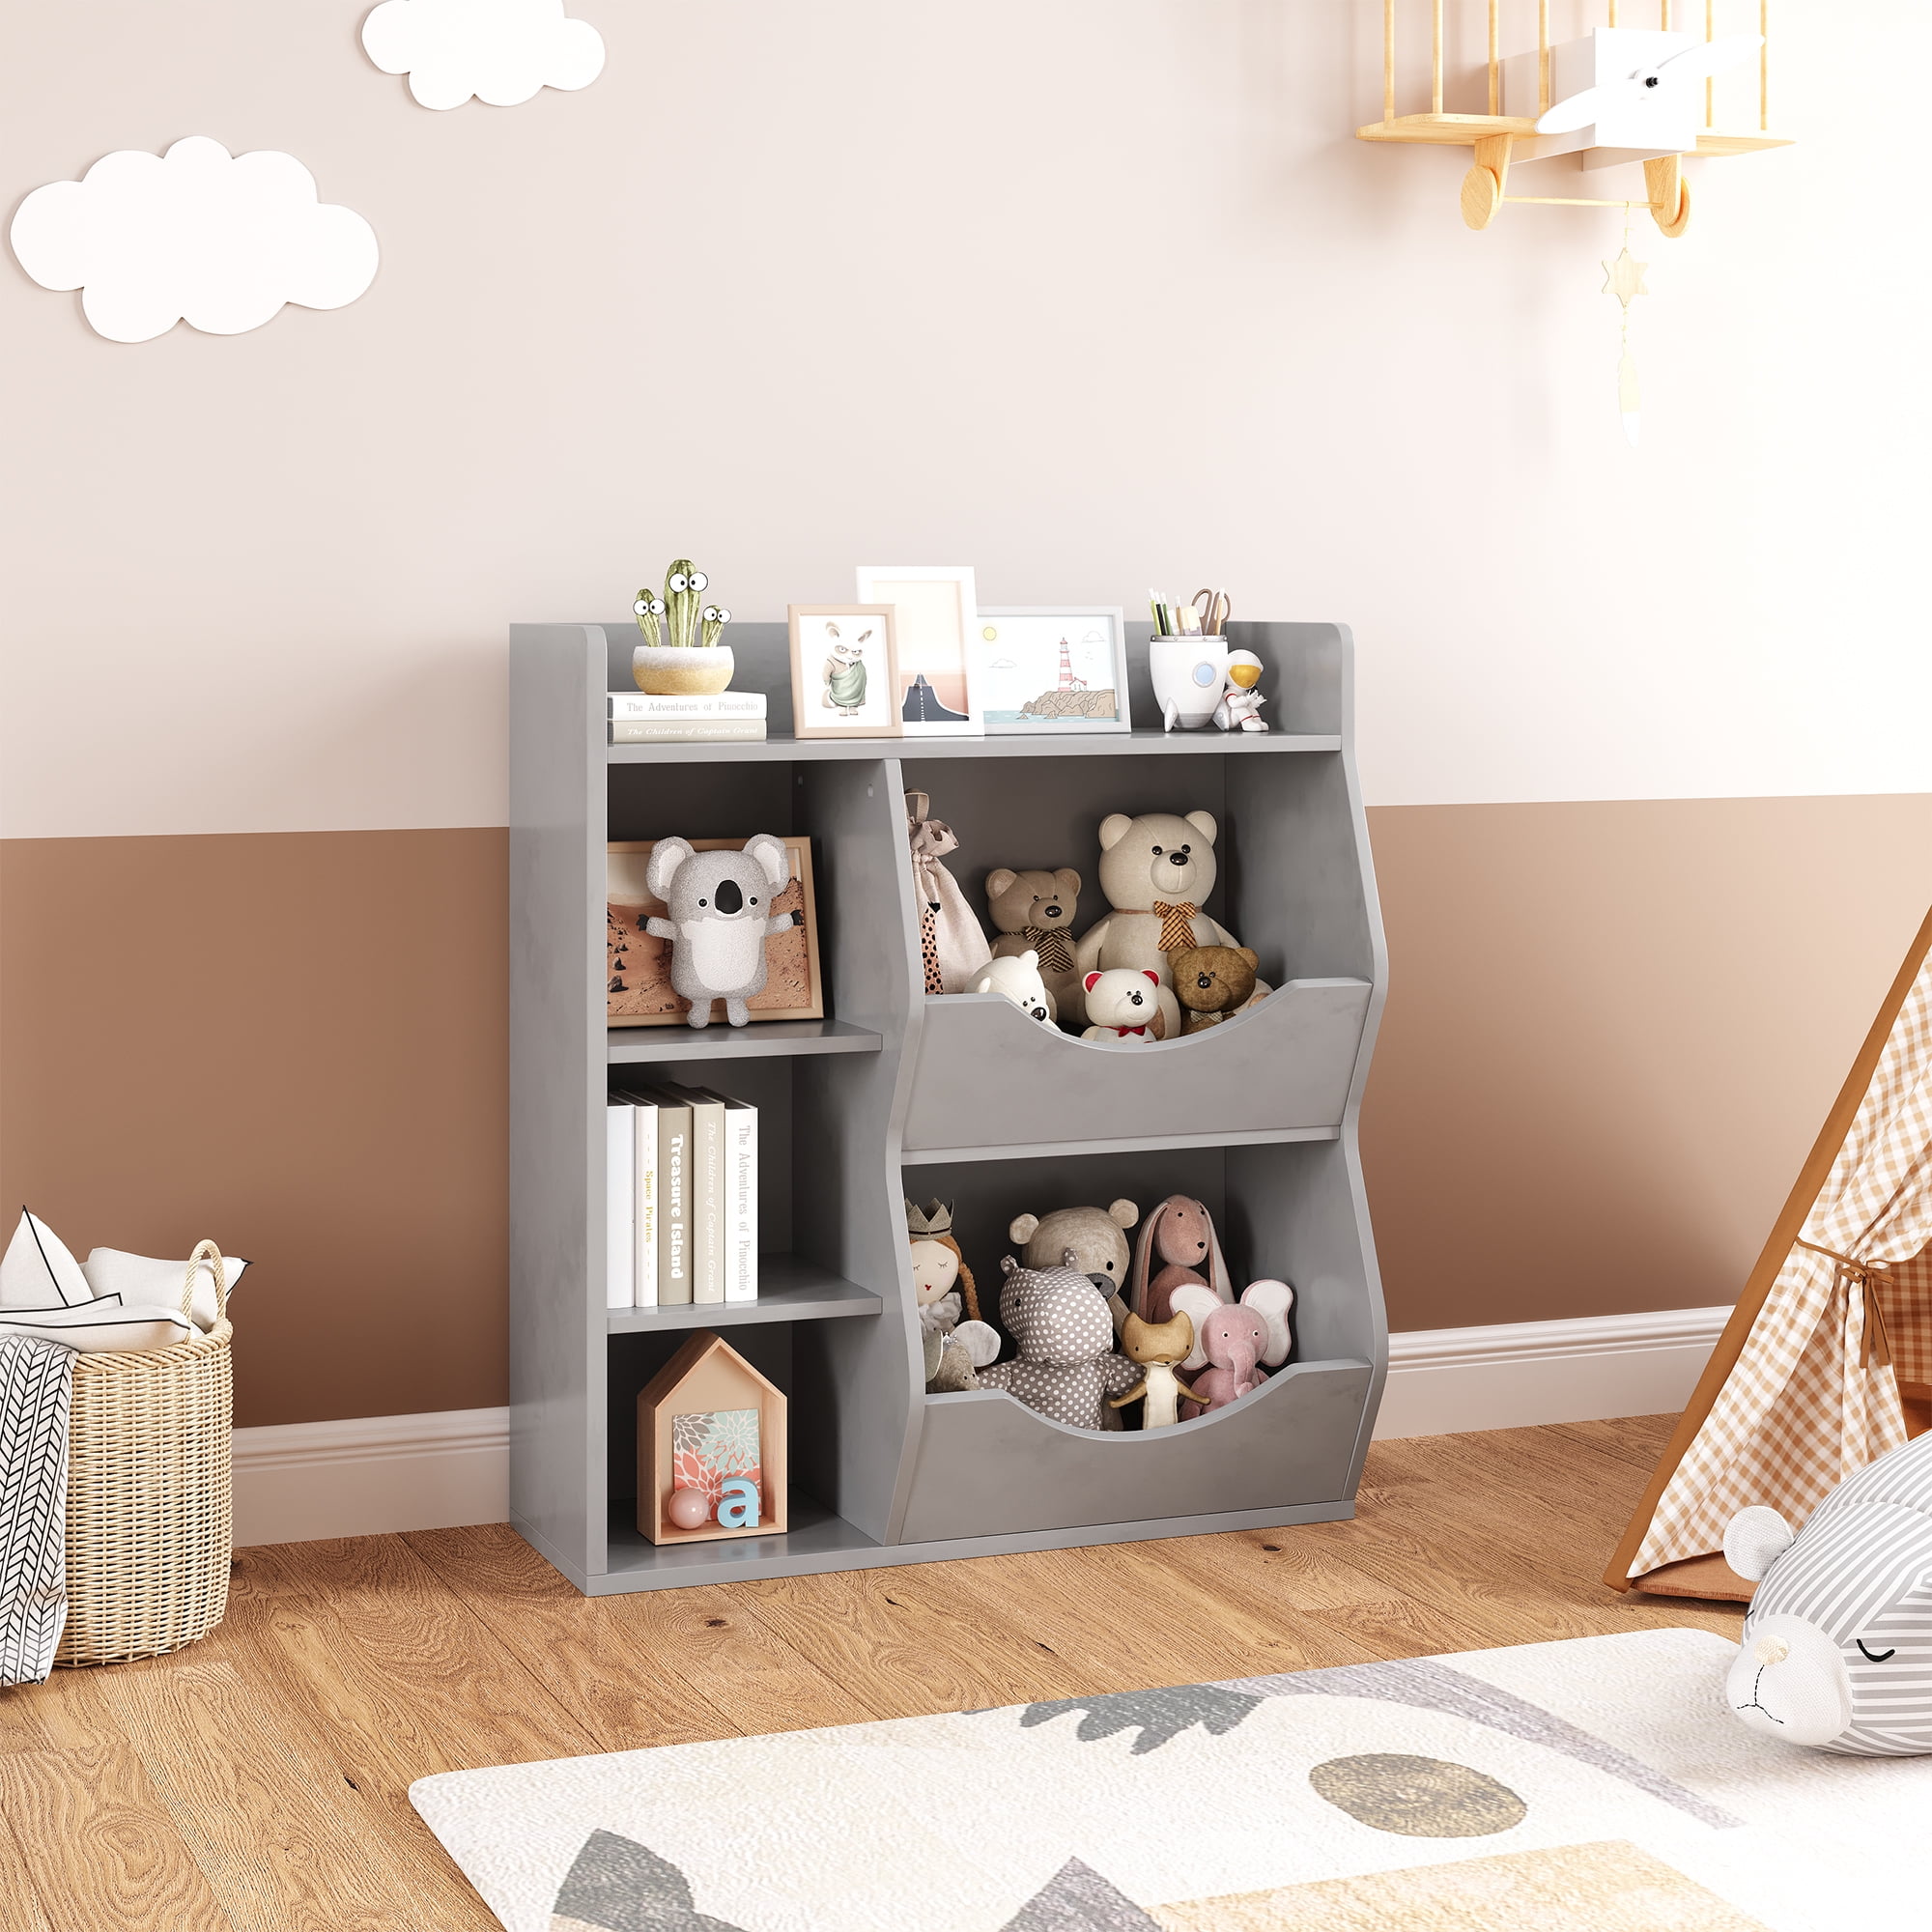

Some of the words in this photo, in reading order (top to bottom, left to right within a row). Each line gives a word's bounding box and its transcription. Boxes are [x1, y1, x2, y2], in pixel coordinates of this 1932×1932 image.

[626, 702, 643, 712] The
[648, 702, 698, 712] Adventures
[703, 702, 712, 711] of
[718, 701, 758, 711] Pinocchio
[686, 727, 696, 736] of
[697, 727, 730, 736] Captain
[733, 726, 758, 735] Grant
[738, 1125, 751, 1146] The
[644, 1171, 654, 1200] Space
[670, 1134, 684, 1218] Treasure
[738, 1152, 751, 1215] Adventures
[706, 1197, 716, 1208] of
[645, 1207, 654, 1243] Pirates
[706, 1212, 716, 1256] Captain
[738, 1221, 751, 1233] of
[670, 1223, 684, 1279] Island
[738, 1239, 751, 1291] Pinocchio
[717, 1475, 759, 1528] a
